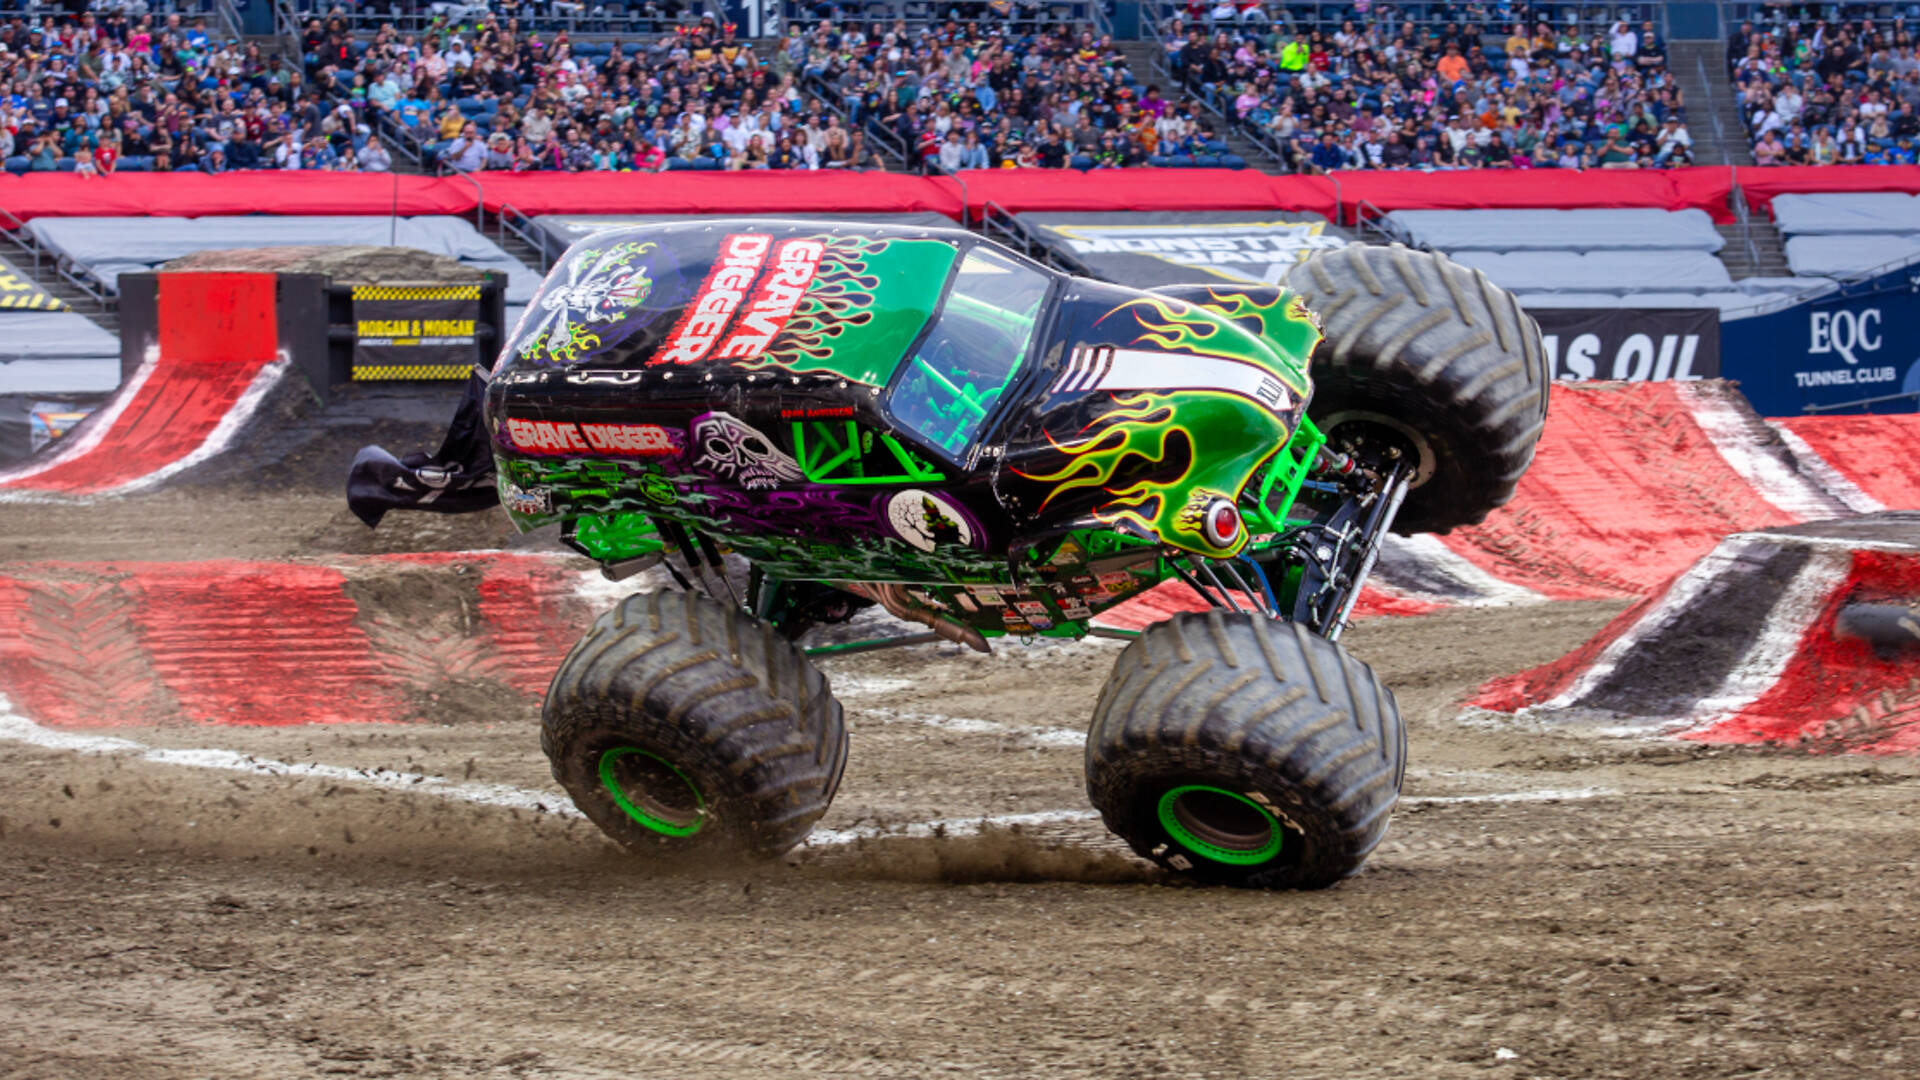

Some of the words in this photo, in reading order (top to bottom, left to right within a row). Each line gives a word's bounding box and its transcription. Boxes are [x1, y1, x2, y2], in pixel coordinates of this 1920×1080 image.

[1065, 235, 1347, 253] MONSTER
[1172, 250, 1298, 264] JAM
[662, 235, 770, 363] DIGGER
[718, 240, 824, 358] GRAVE
[357, 320, 409, 336] MORGAN
[411, 320, 421, 336] &
[423, 320, 474, 336] MORGAN
[1808, 308, 1882, 364] EQC
[1612, 333, 1704, 382] OIL
[1795, 369, 1855, 387] TUNNEL
[1856, 366, 1896, 383] CLUB
[507, 418, 590, 449] GRAVE
[581, 424, 676, 450] DIGGER
